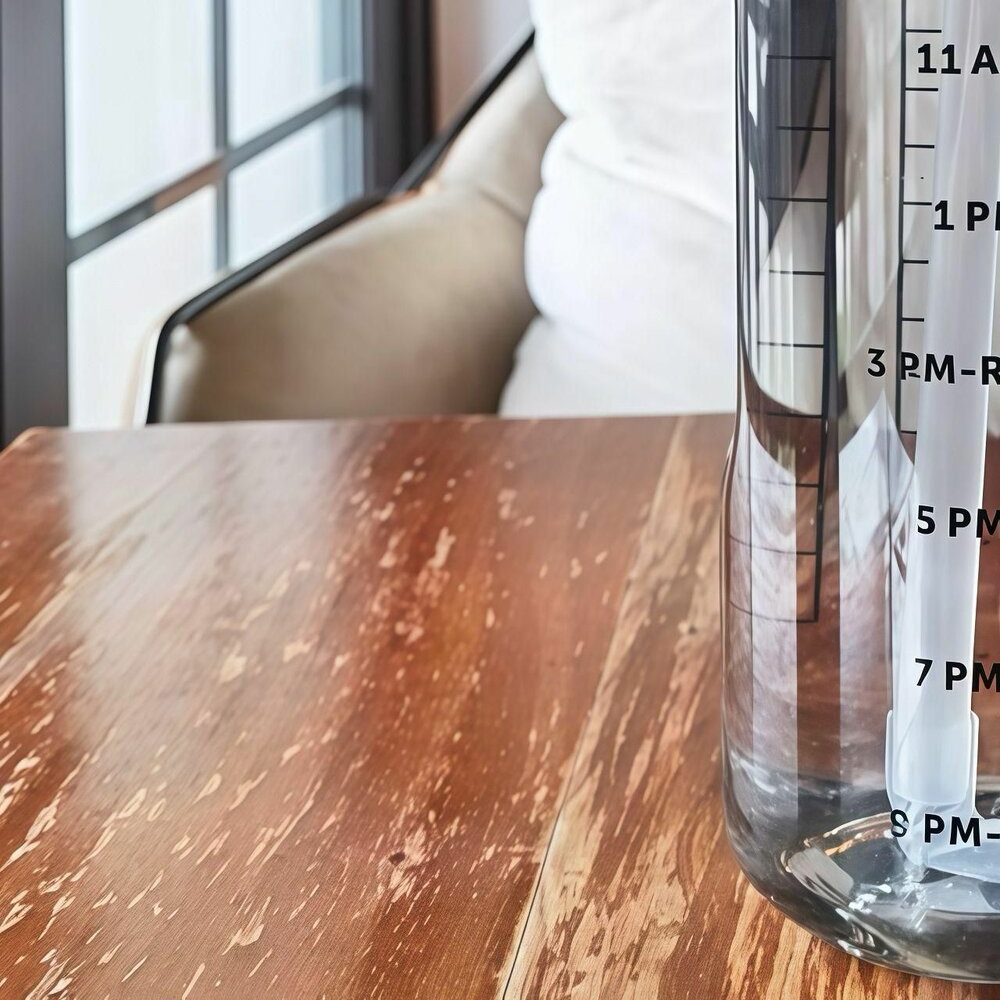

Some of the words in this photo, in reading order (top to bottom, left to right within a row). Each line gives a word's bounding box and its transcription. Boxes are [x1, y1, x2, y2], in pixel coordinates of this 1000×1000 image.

[917, 43, 962, 75] 11
[934, 200, 955, 231] 1
[867, 348, 886, 377] 3
[917, 505, 936, 535] 5
[914, 658, 933, 687] 7
